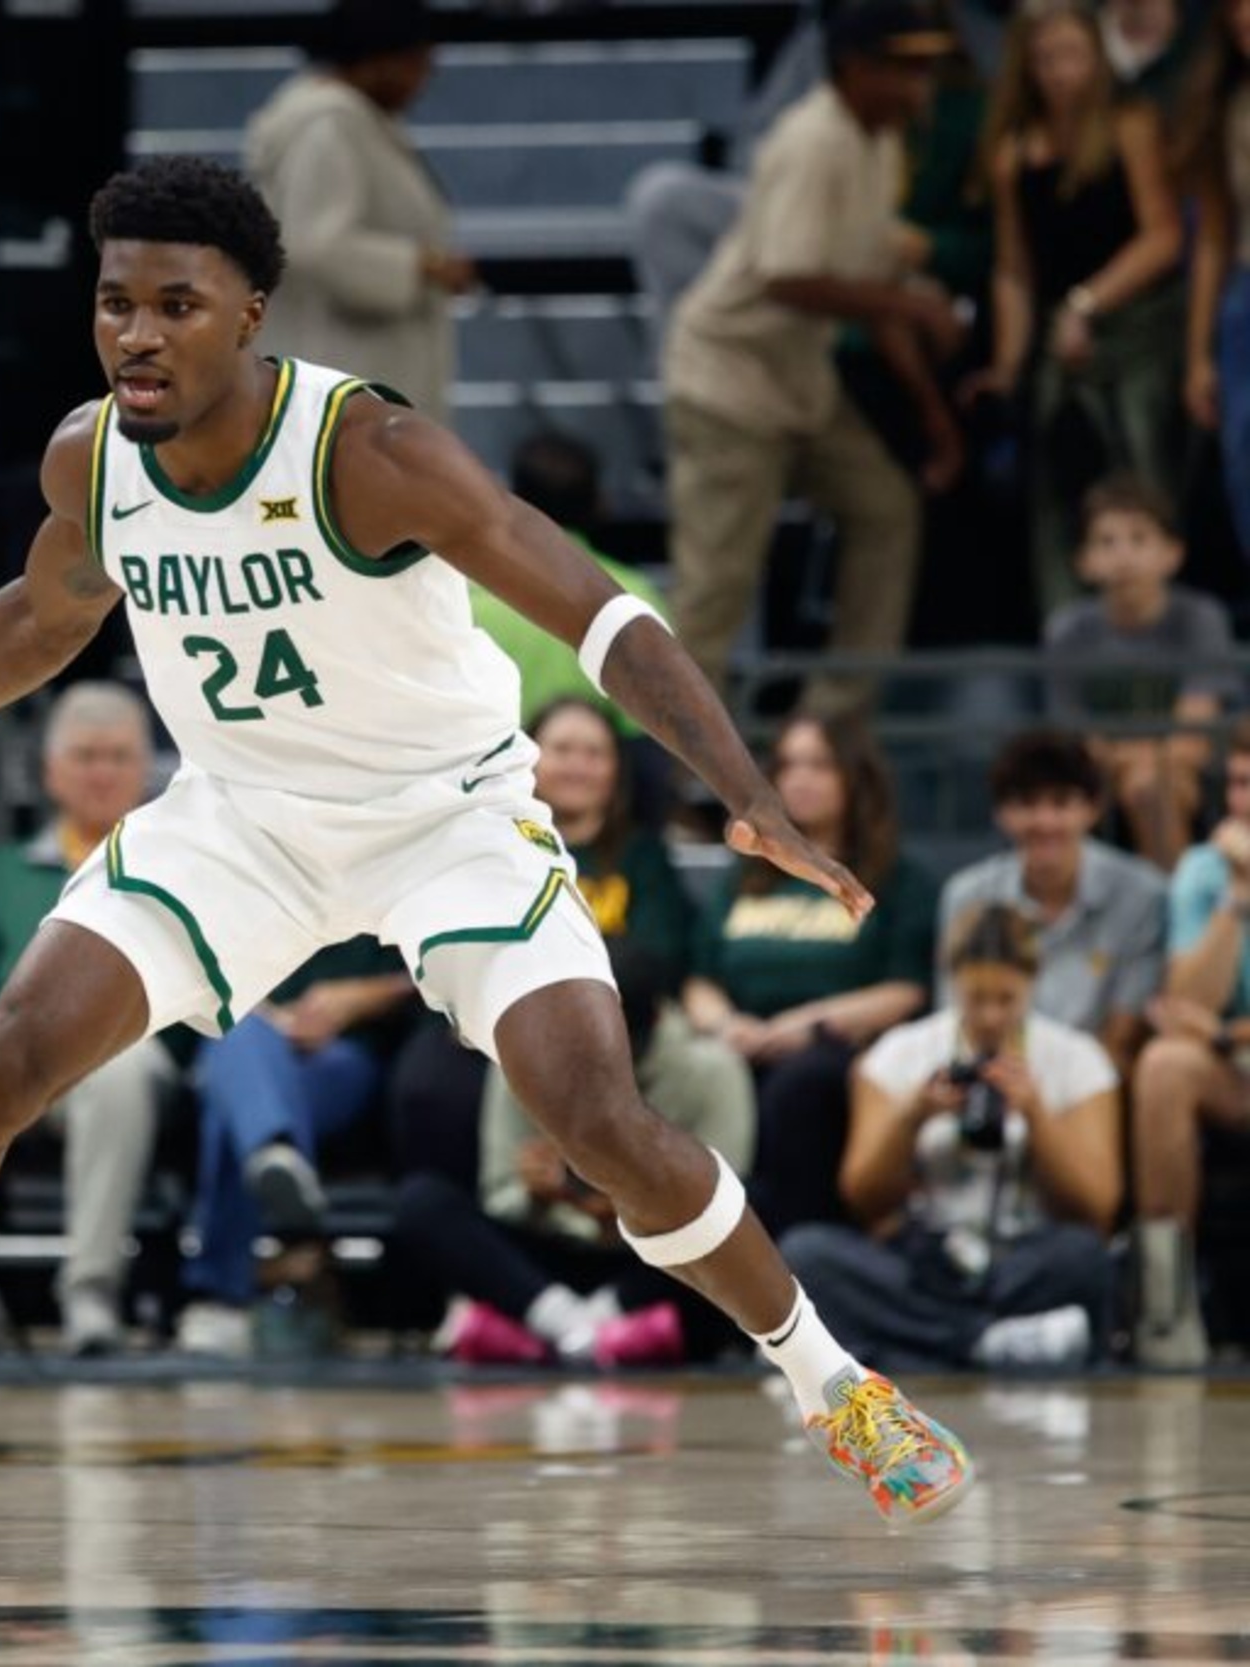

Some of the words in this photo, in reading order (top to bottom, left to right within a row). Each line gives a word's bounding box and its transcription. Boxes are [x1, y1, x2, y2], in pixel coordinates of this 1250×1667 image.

[259, 496, 299, 522] XII
[120, 547, 323, 616] BAYLOR
[182, 628, 324, 722] 24
